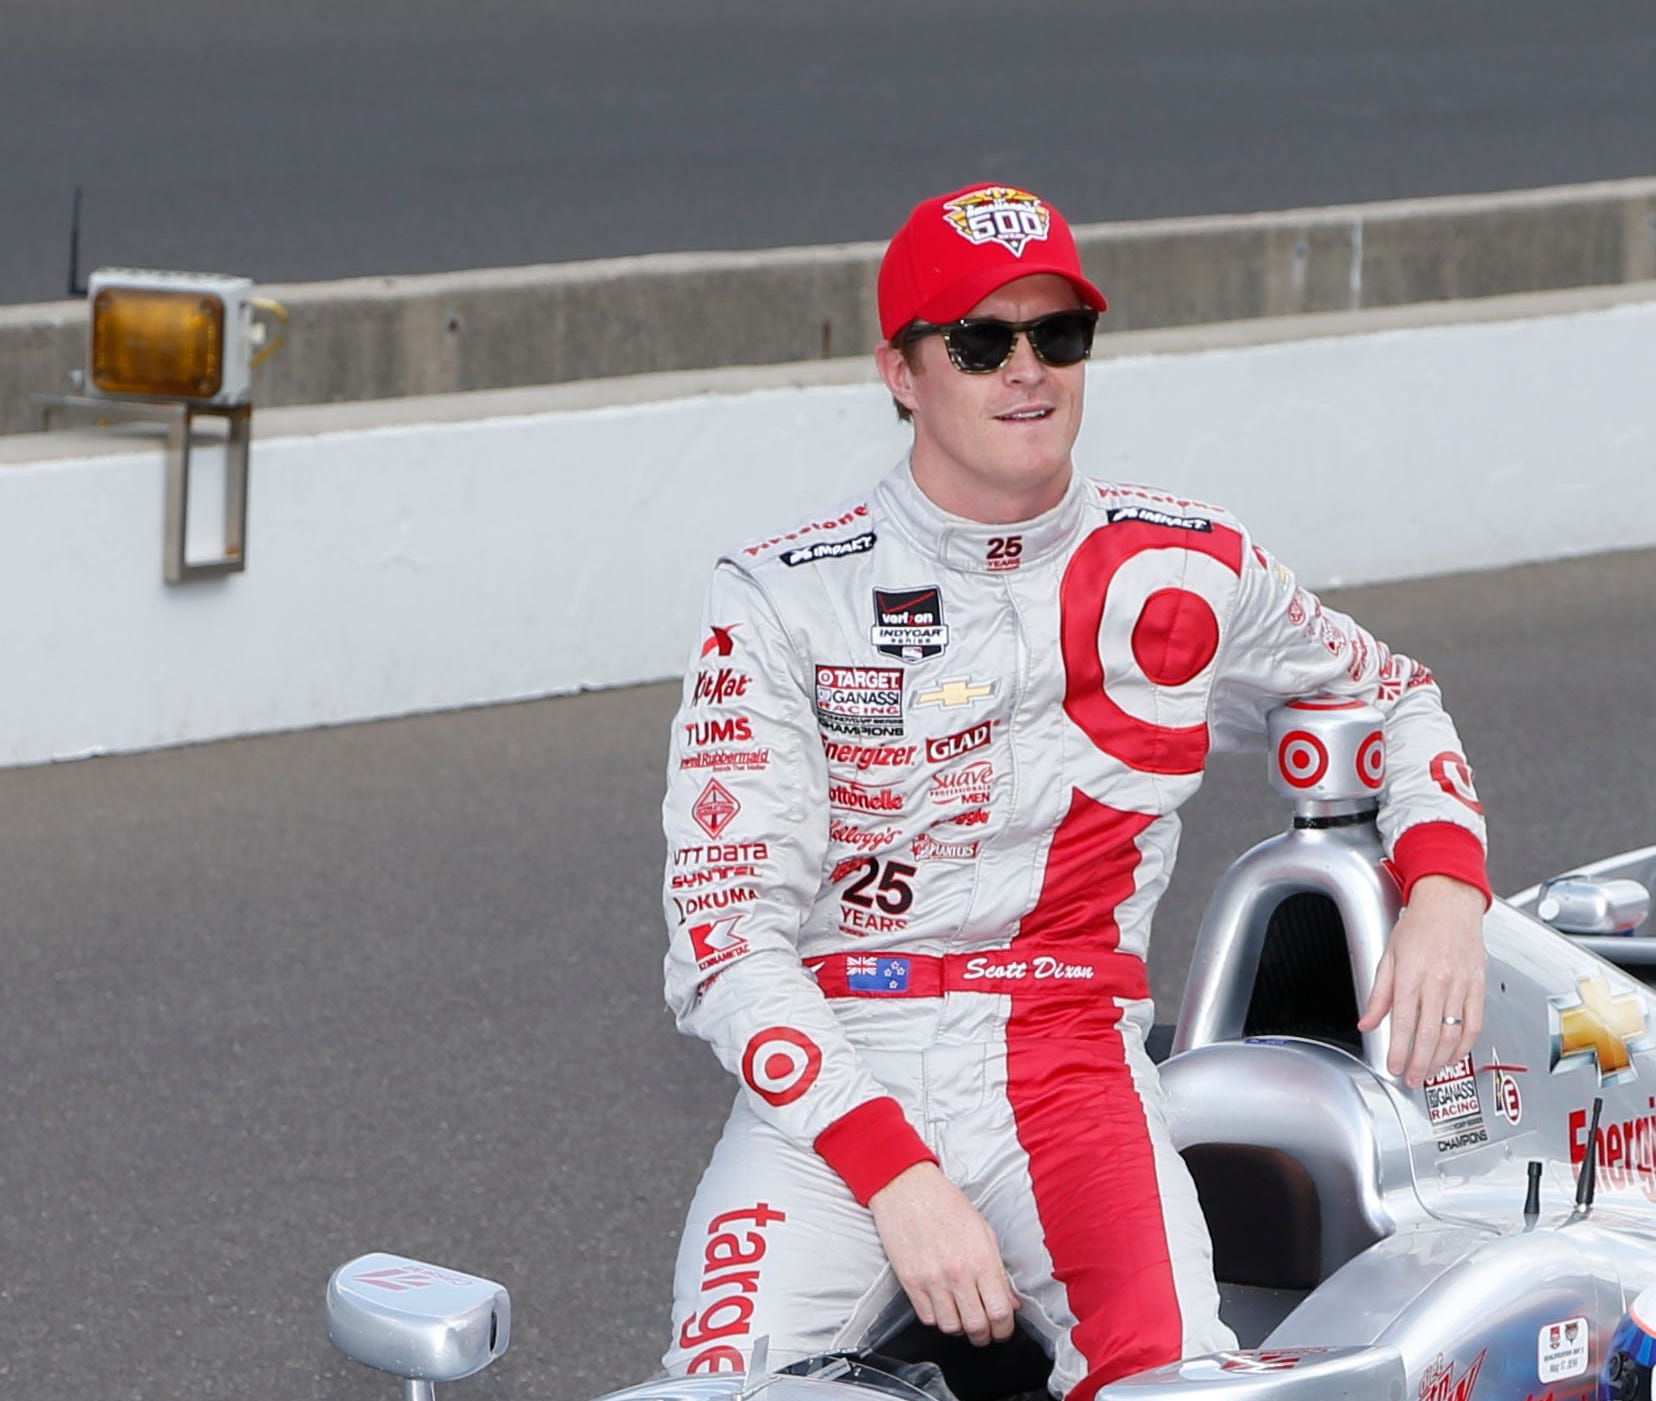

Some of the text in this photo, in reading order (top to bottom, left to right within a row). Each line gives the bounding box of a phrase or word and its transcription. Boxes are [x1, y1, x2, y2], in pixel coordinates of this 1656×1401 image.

[967, 211, 1044, 241] 500
[986, 536, 1023, 559] 25
[882, 610, 934, 625] verizon
[880, 626, 944, 638] INDYCAR
[835, 669, 900, 689] TARGET
[818, 702, 900, 715] RACING
[833, 690, 899, 706] GANASSI
[685, 716, 752, 746] TUMS
[818, 719, 905, 737] CHAMPIONS
[930, 726, 988, 758] GLAD
[931, 762, 994, 790] Suave
[829, 781, 905, 811] ottonelle
[961, 793, 992, 805] MEN
[841, 857, 918, 915] 25
[686, 888, 760, 915] OKUMA
[840, 904, 908, 932] YEARS
[963, 956, 1095, 980] Scott Dixon
[1431, 1100, 1479, 1120] RACING
[1437, 1128, 1488, 1153] CHAMPIONS
